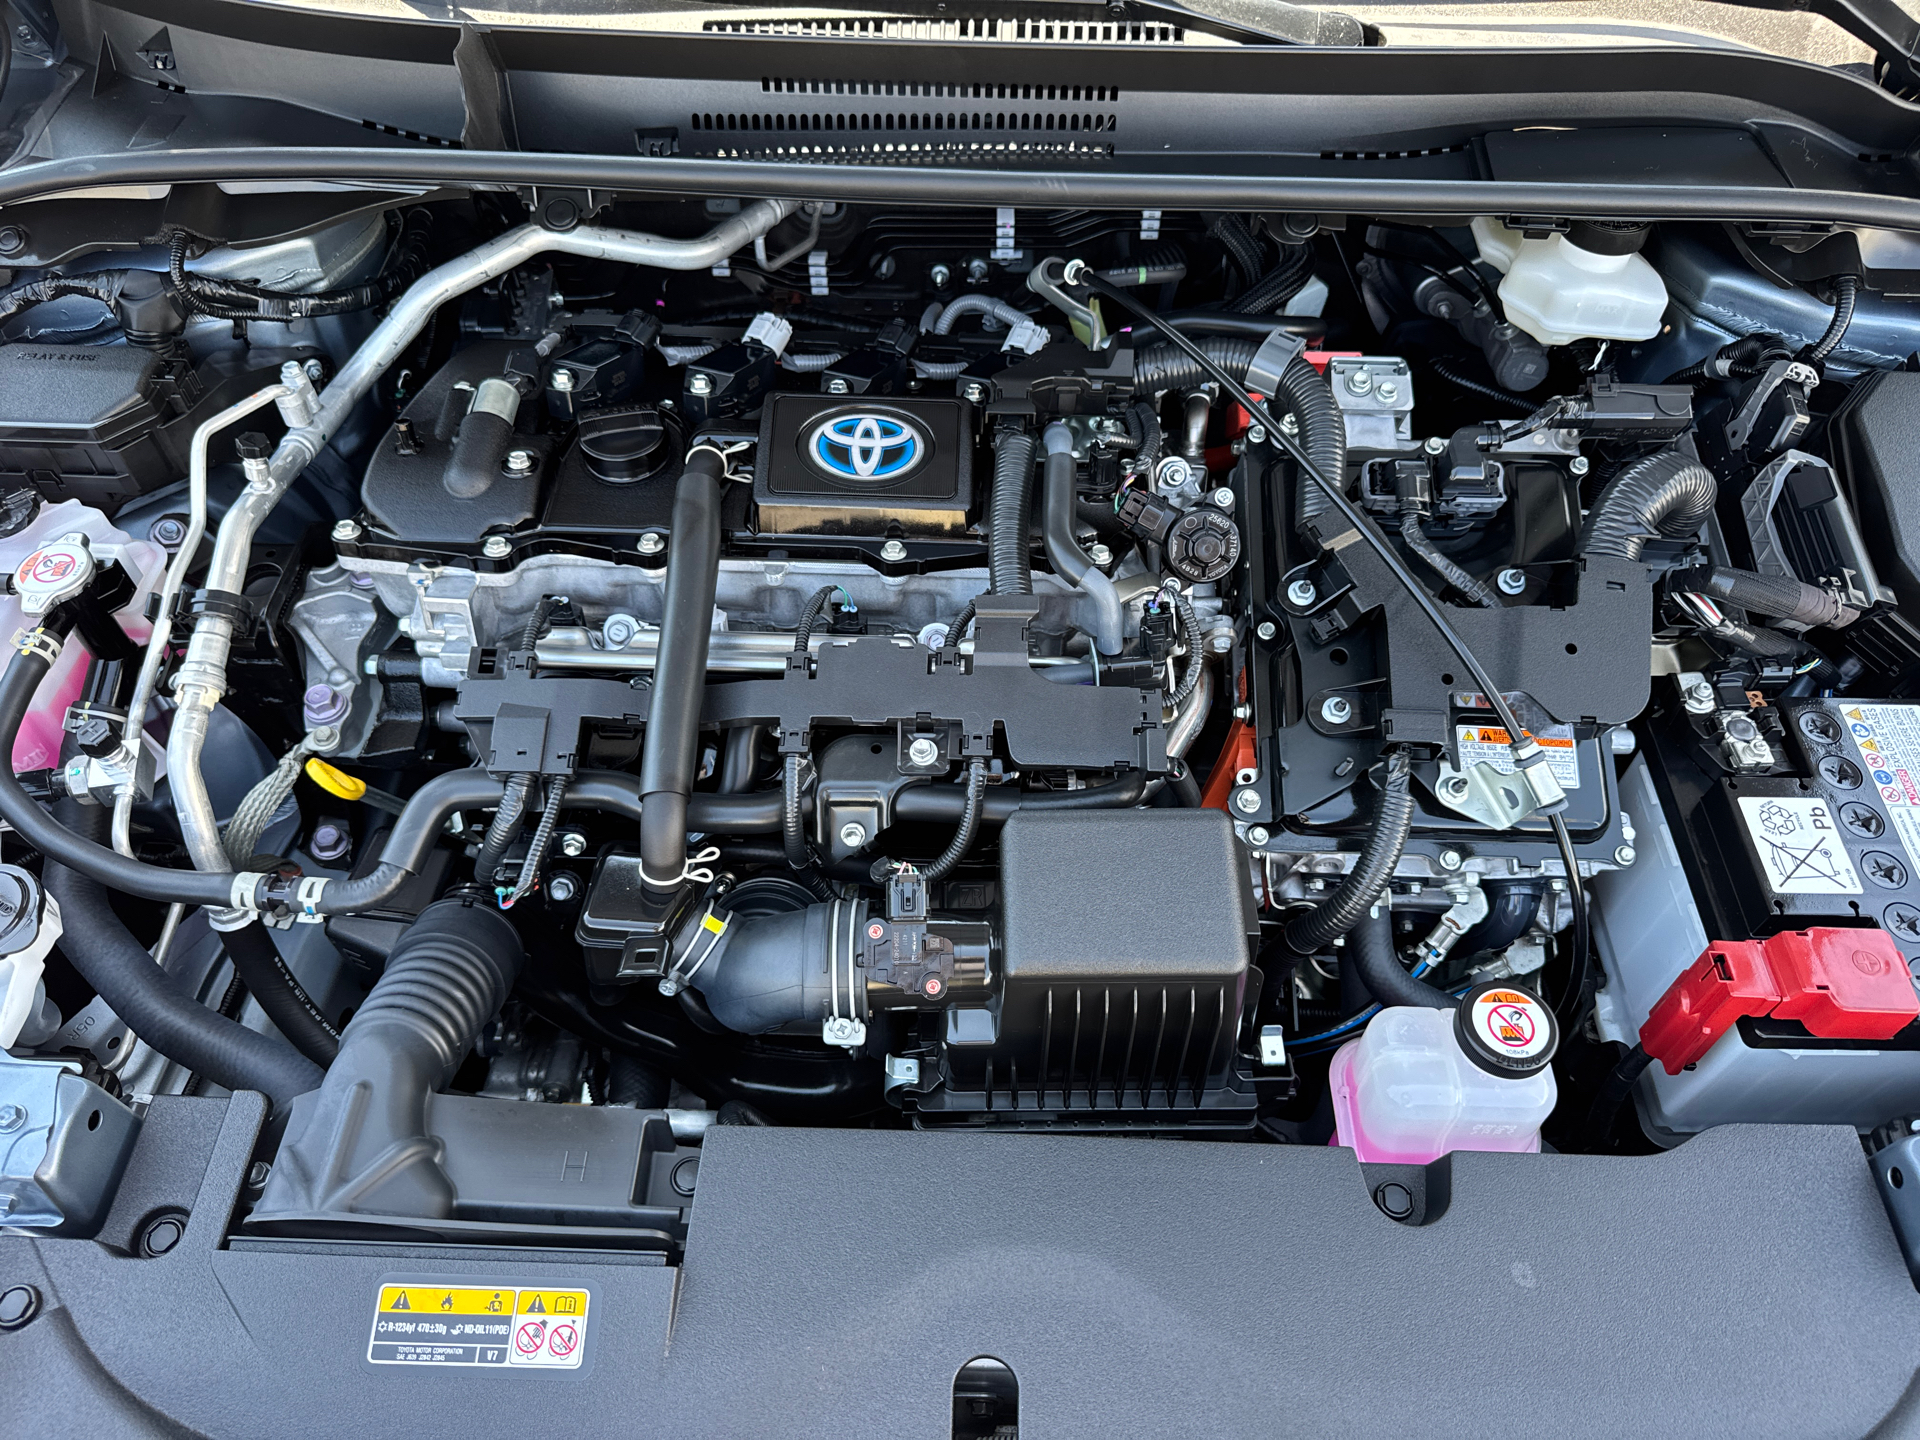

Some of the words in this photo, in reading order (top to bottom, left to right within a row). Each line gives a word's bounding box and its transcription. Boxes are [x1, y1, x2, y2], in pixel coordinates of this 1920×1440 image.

[17, 352, 55, 361] RELAY
[1208, 513, 1230, 529] 25620
[1208, 565, 1229, 577] TOYOTA
[1867, 708, 1885, 731] GASES
[1878, 731, 1904, 768] EXPLOSIVE
[1897, 770, 1917, 798] DANGER
[1809, 807, 1832, 830] Pb
[66, 1016, 96, 1041] 05R
[560, 1150, 589, 1183] H
[415, 1346, 432, 1354] MOTOR
[432, 1347, 463, 1355] CORPORATION
[486, 1350, 499, 1361] V7
